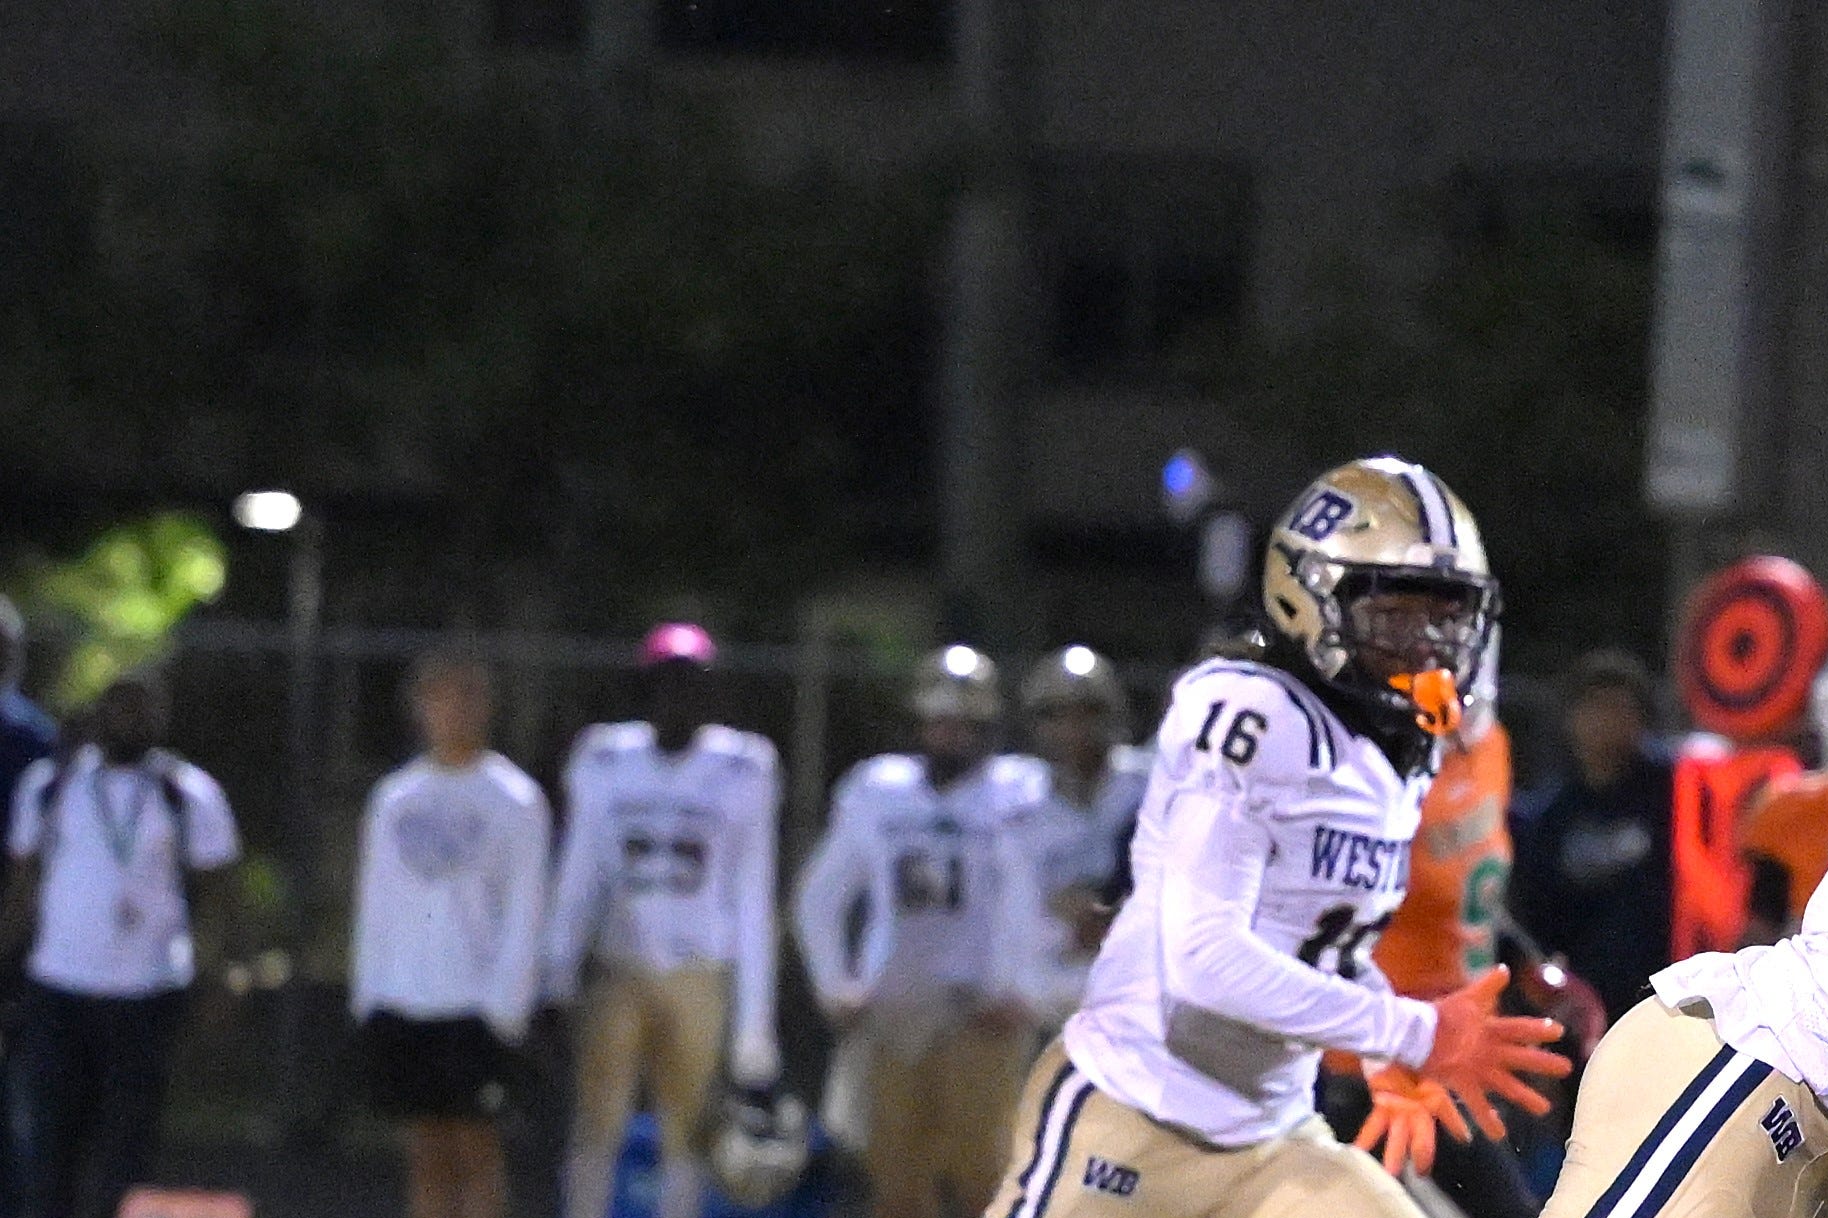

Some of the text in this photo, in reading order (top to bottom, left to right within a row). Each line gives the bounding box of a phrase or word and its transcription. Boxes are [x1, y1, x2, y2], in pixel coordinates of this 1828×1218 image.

[1195, 700, 1268, 766] 16
[1759, 1094, 1806, 1163] WB
[1083, 1156, 1139, 1196] WB
